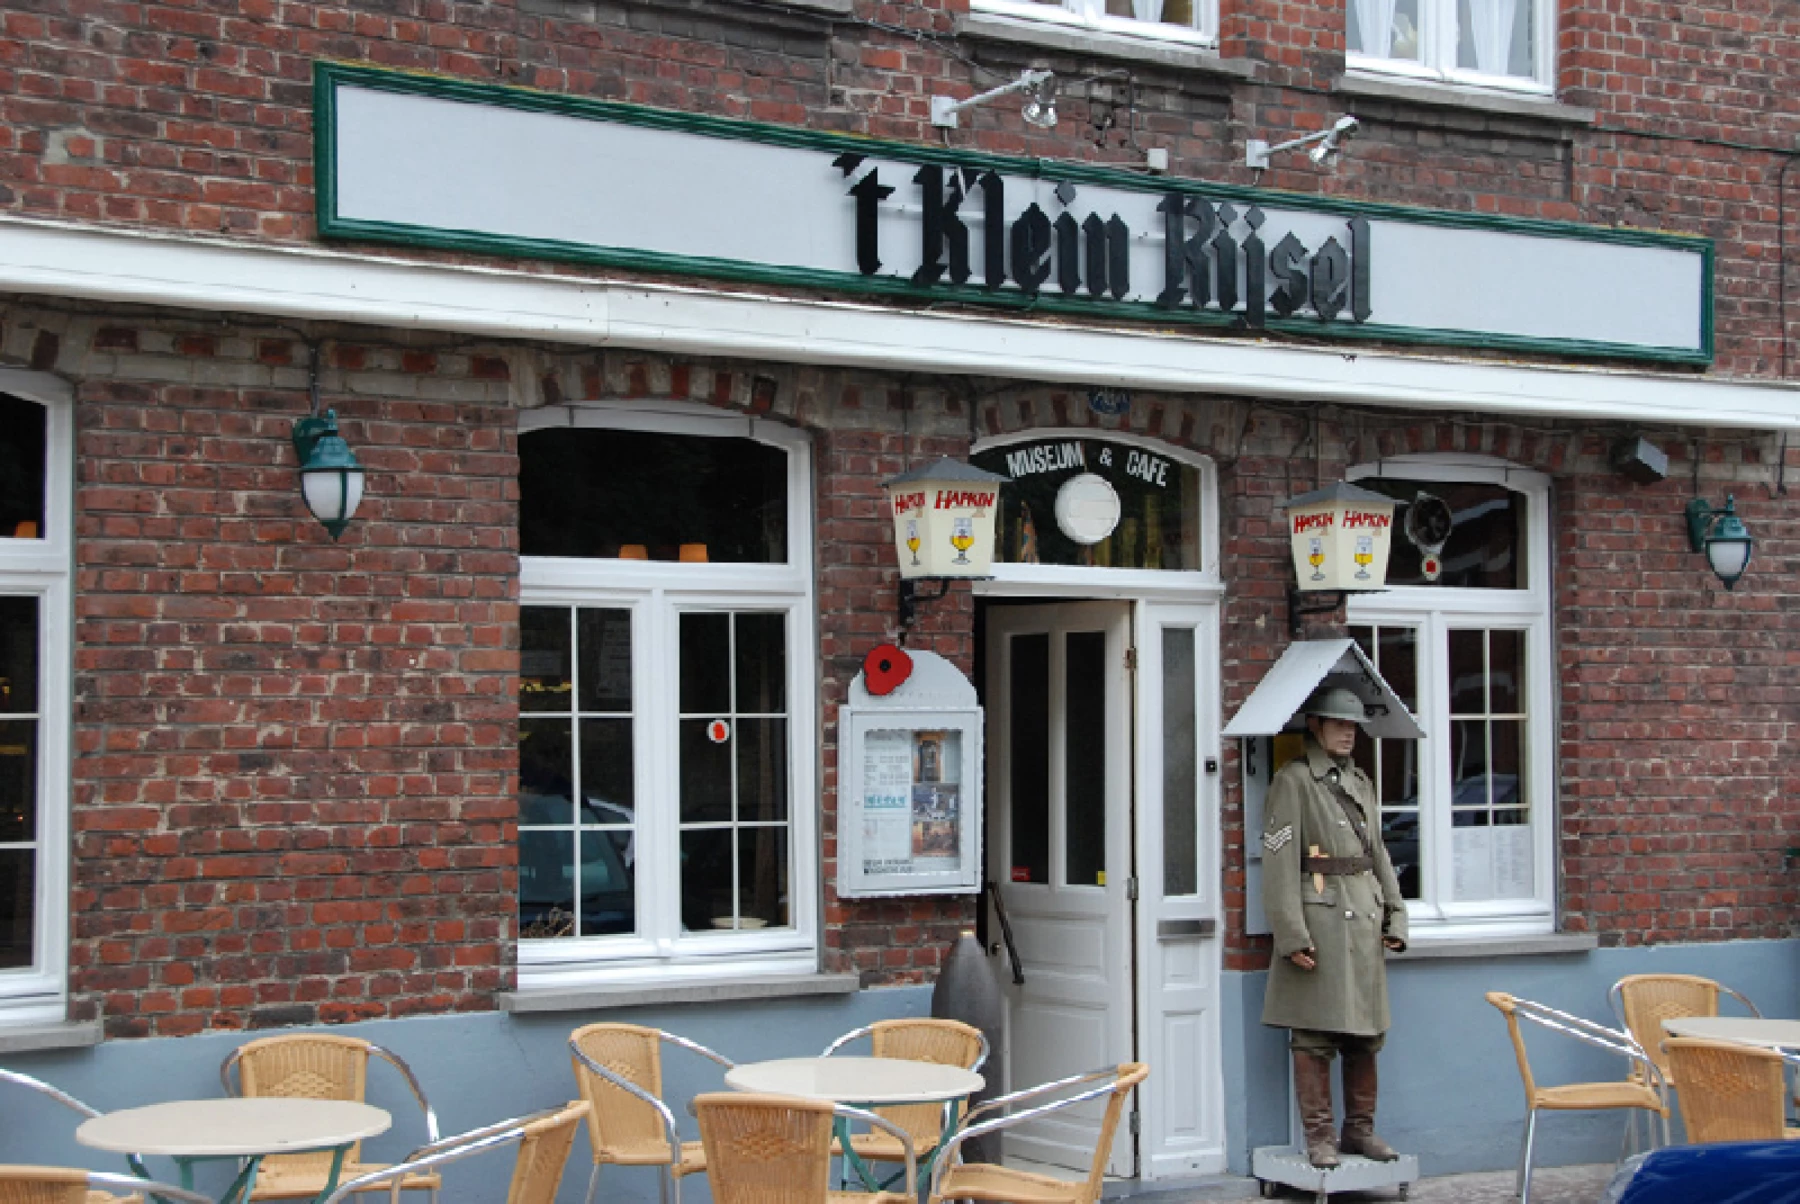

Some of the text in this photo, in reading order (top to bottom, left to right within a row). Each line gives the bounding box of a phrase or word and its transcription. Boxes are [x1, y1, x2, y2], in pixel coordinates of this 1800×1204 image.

[911, 163, 1130, 299] Klein
[1156, 191, 1372, 329] Rijsel
[1006, 441, 1171, 487] MUSEUM & CAFE
